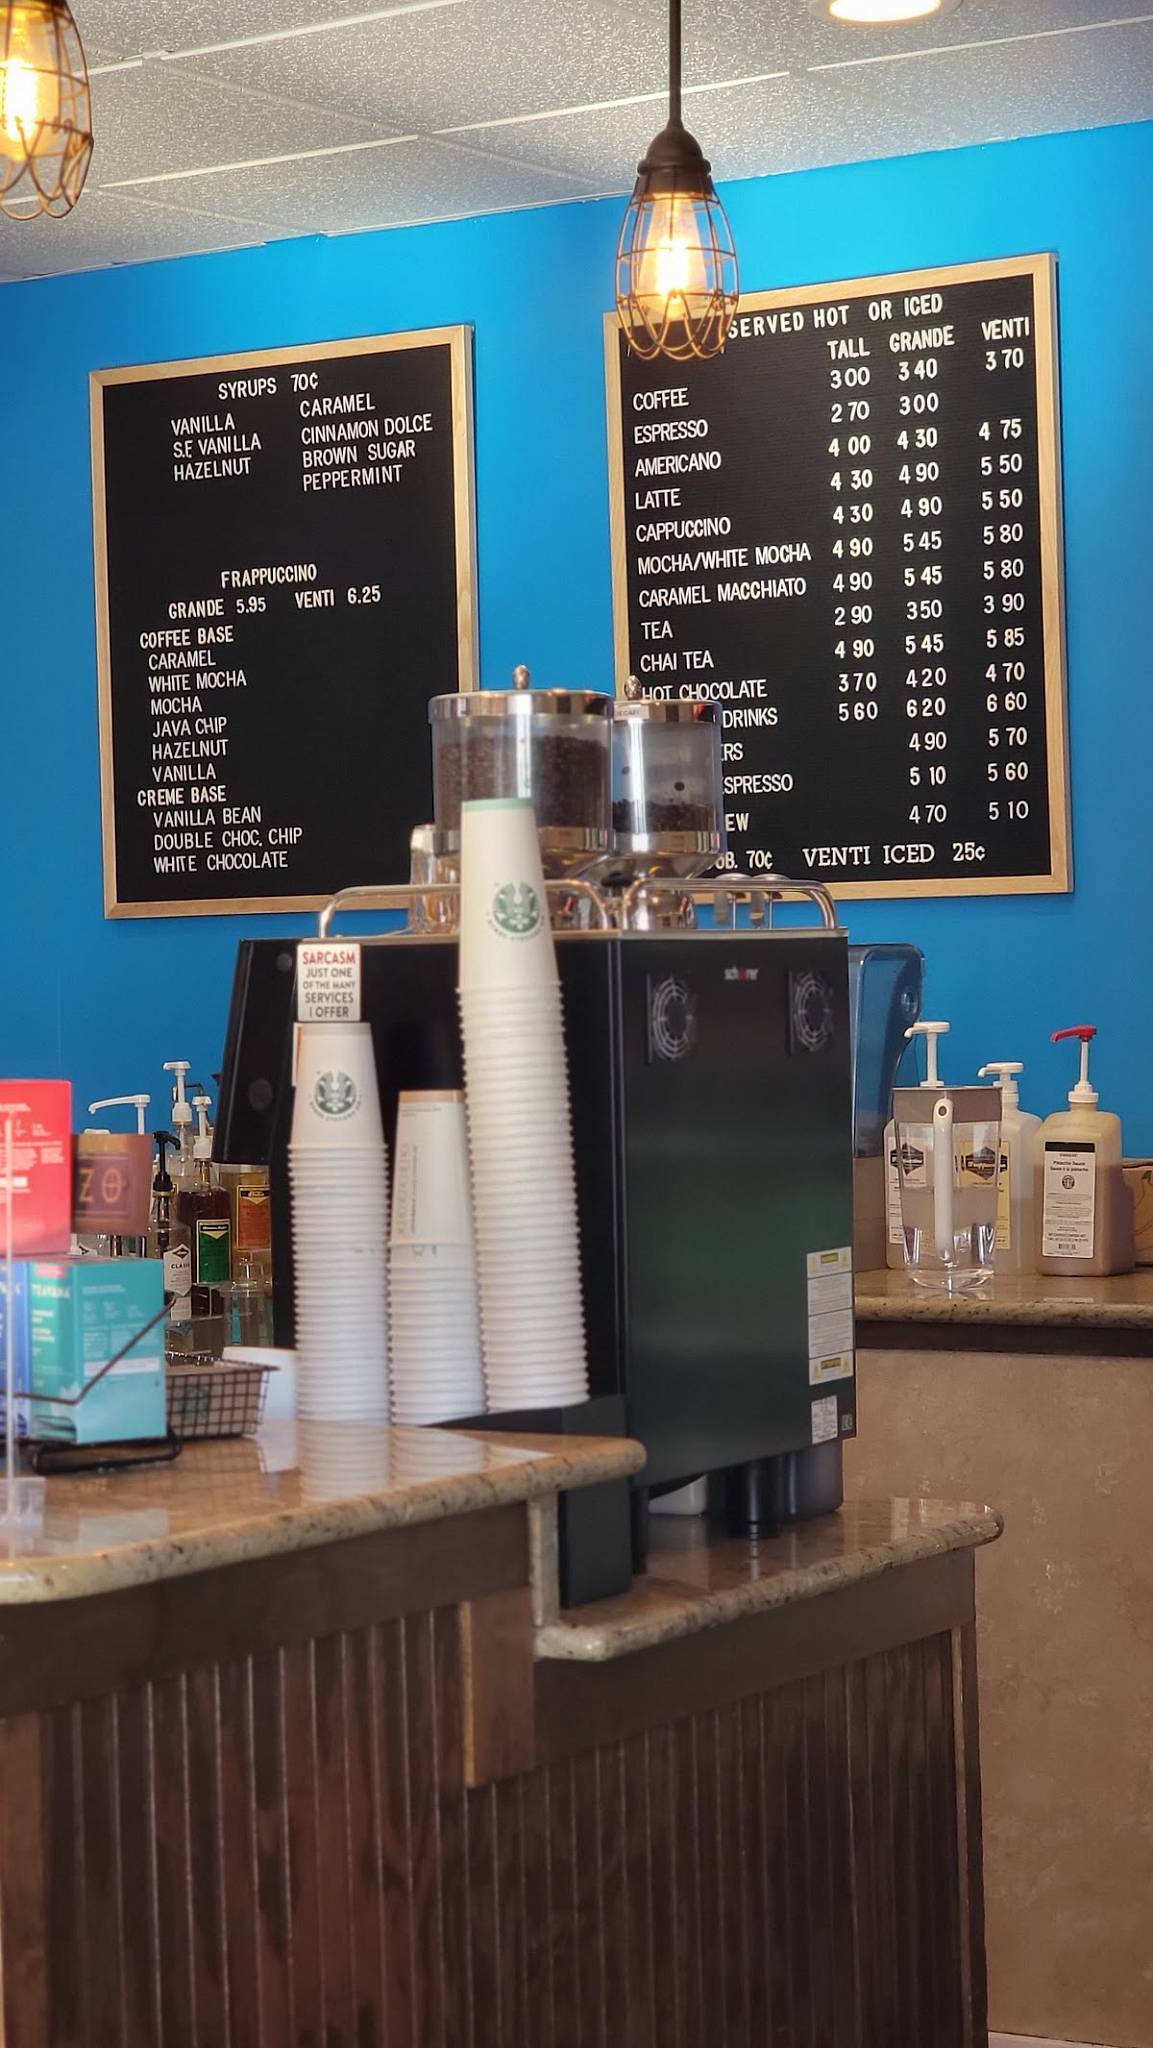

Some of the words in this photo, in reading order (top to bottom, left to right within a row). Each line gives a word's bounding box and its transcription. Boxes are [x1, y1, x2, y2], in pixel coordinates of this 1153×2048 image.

[727, 310, 805, 340] SERVED
[812, 304, 851, 329] HOT
[867, 299, 893, 322] OR
[903, 292, 944, 318] ICED
[826, 336, 872, 361] TALL
[888, 324, 956, 354] GRANDE
[980, 316, 1030, 341] VENTI
[218, 376, 277, 400] SYRUPS
[290, 371, 319, 393] 70¢
[299, 392, 376, 418] CARAMEL
[632, 387, 690, 412] COFFEE
[170, 412, 236, 437] VANILLA
[300, 419, 379, 445] CINNAMON
[383, 412, 434, 436] DOLCE
[634, 418, 709, 445] ESPRESSO
[197, 432, 262, 456] VANILLA
[302, 445, 358, 469] BROWN
[367, 439, 416, 461] SUGAR
[173, 456, 252, 482] HAZELNUT
[634, 450, 722, 478] AMERICANO
[302, 464, 403, 492] PEPPERMINT
[635, 487, 682, 510] LATTE
[635, 516, 732, 543] CAPPUCCINO
[637, 547, 749, 576] MOCHA/WHITE
[754, 542, 812, 566] MOCHA
[220, 563, 318, 589] FRAPPUCCINO
[168, 598, 225, 620] GRANDE
[236, 595, 267, 614] 5.95
[294, 588, 335, 609] VENTI
[347, 584, 381, 605] 6.25
[638, 584, 712, 608] CARAMEL
[717, 576, 807, 602] MACCHIATO
[139, 628, 192, 649] COFFEE
[197, 624, 234, 645] BASE
[640, 620, 674, 640] TEA
[148, 649, 217, 671] CARAMEL
[640, 652, 678, 673] CHAI
[682, 649, 715, 670] TEA
[148, 673, 192, 693] WHITE
[196, 669, 247, 690] MOCHA
[642, 684, 673, 700] HOT
[680, 679, 767, 700] CHOCOLATE
[150, 695, 203, 716] MOCHA
[721, 706, 779, 729] DRINKS
[152, 718, 192, 738] JAVA
[194, 716, 228, 735] CHIP
[152, 738, 229, 761] HAZELNUT
[721, 742, 743, 762] RS
[151, 762, 217, 783] VANILLA
[722, 773, 793, 795] SPRESSO
[137, 787, 185, 807] CREME
[190, 784, 227, 804] BASE
[152, 808, 216, 828] VANILLA
[222, 805, 262, 825] BEAN
[154, 831, 214, 851] DOUBLE
[221, 829, 263, 848] CHOC.
[268, 826, 303, 845] CHIP
[153, 855, 198, 874] WHITE
[206, 850, 289, 871] CHOCOLATE
[745, 849, 774, 870] 70¢
[802, 846, 870, 867] VENTI
[883, 844, 934, 864] ICED
[953, 842, 985, 861] 25¢
[303, 952, 355, 965] SARCASM
[306, 968, 328, 978] JUST
[331, 968, 352, 977] ONE
[316, 981, 330, 989] THE
[333, 981, 356, 989] MANY
[305, 992, 354, 1003] SERVICES
[310, 1007, 312, 1017] I
[315, 1007, 349, 1017] OFFER
